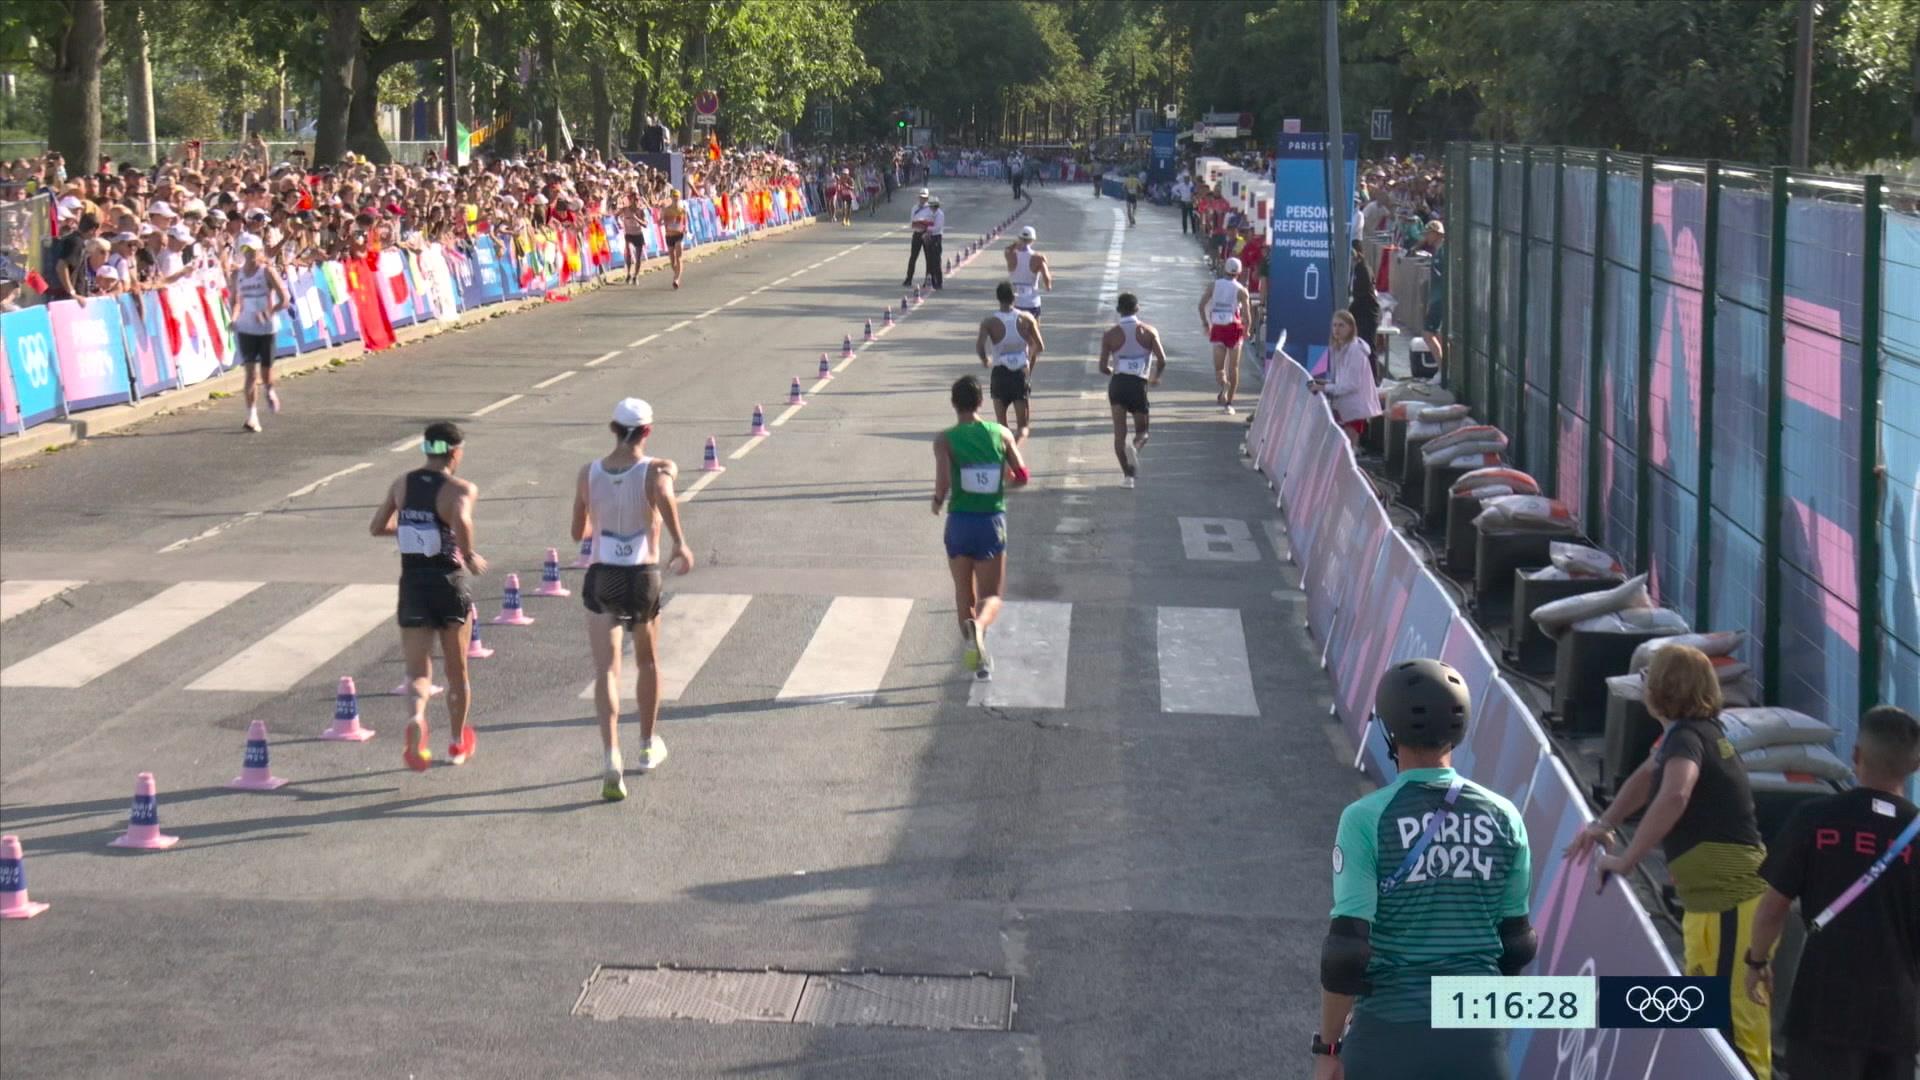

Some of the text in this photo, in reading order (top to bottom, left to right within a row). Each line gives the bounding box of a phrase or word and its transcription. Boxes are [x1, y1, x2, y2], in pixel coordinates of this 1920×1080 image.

[1286, 205, 1334, 218] PERSON
[1274, 220, 1352, 233] REFRESHMT
[1275, 237, 1329, 249] RAFRAÎCHISSE
[975, 471, 989, 485] 15
[1177, 516, 1262, 561] B
[1404, 845, 1493, 883] 2024
